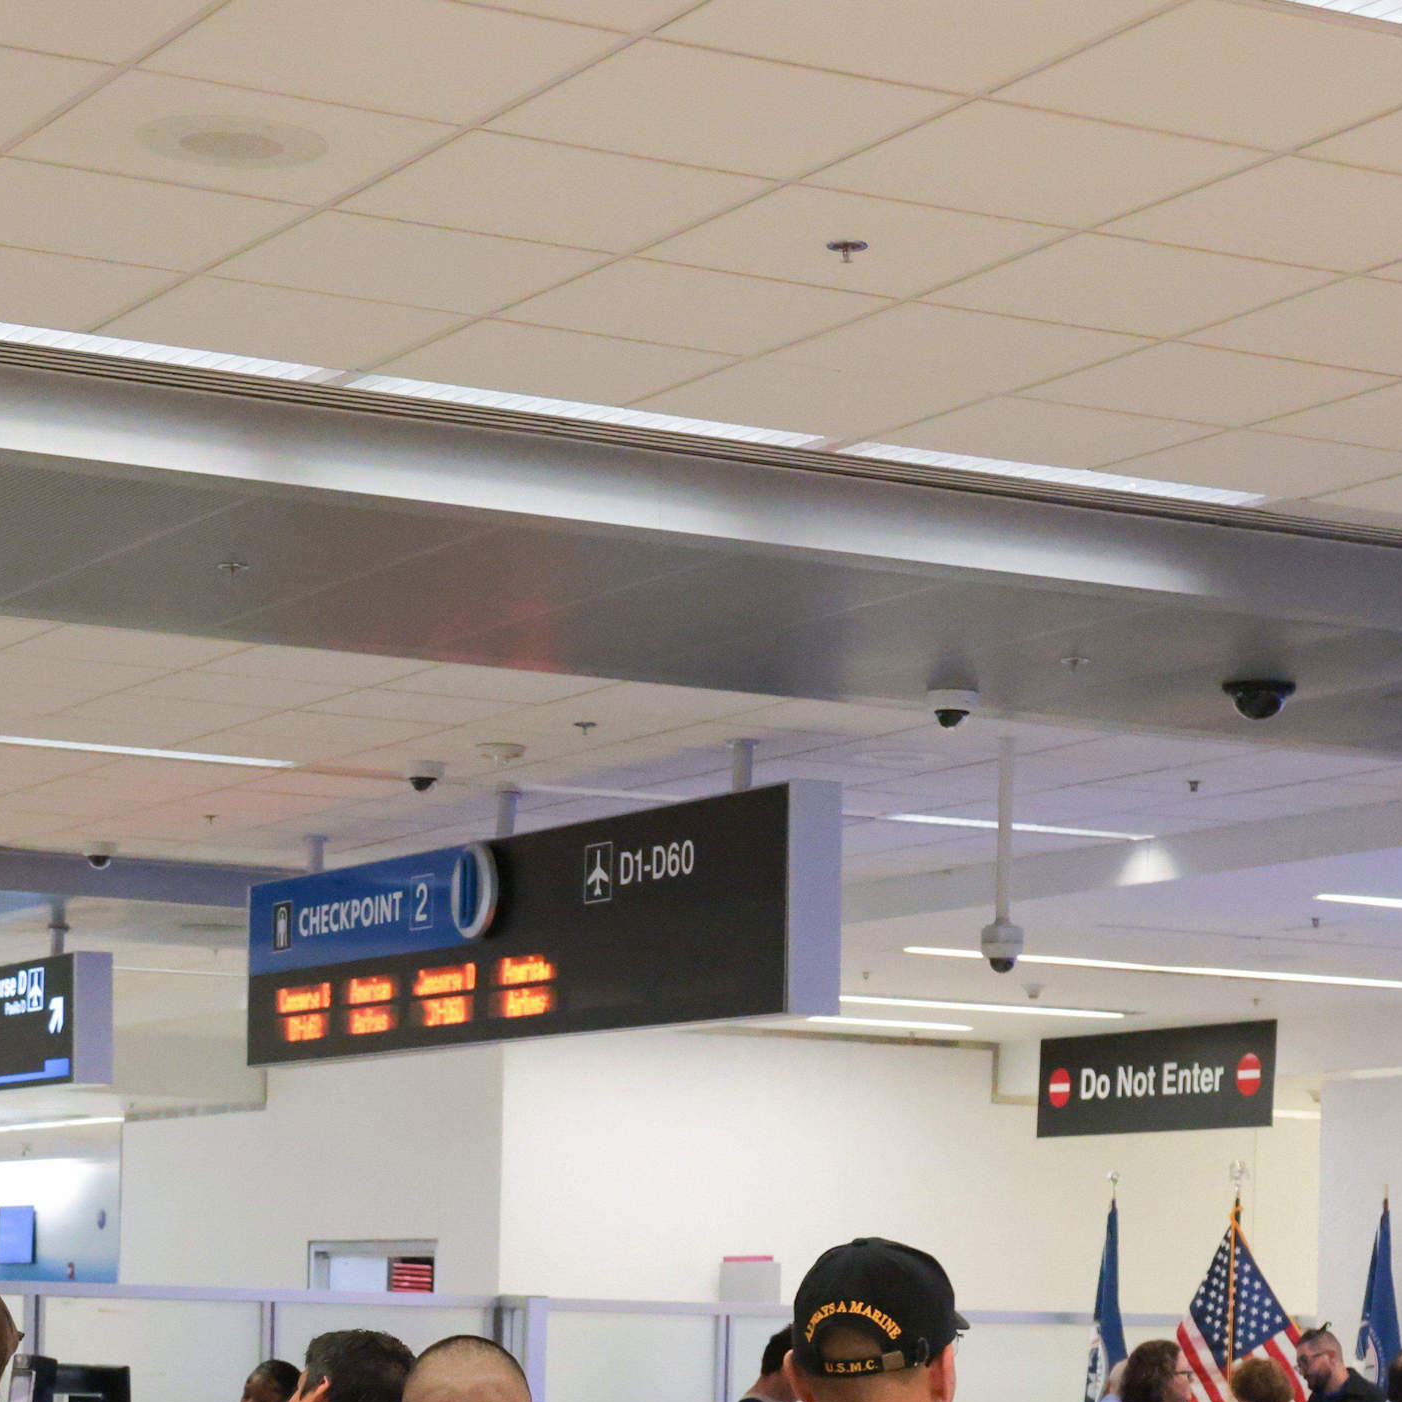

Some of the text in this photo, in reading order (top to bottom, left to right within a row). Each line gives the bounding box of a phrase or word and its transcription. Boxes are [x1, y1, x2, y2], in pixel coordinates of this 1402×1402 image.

[619, 840, 695, 887] D1-D60
[298, 882, 429, 938] CHECKPOINT 2
[18, 970, 28, 996] D
[1080, 1062, 1225, 1101] Do Not Enter
[836, 1300, 848, 1314] A
[848, 1301, 903, 1341] MARINE
